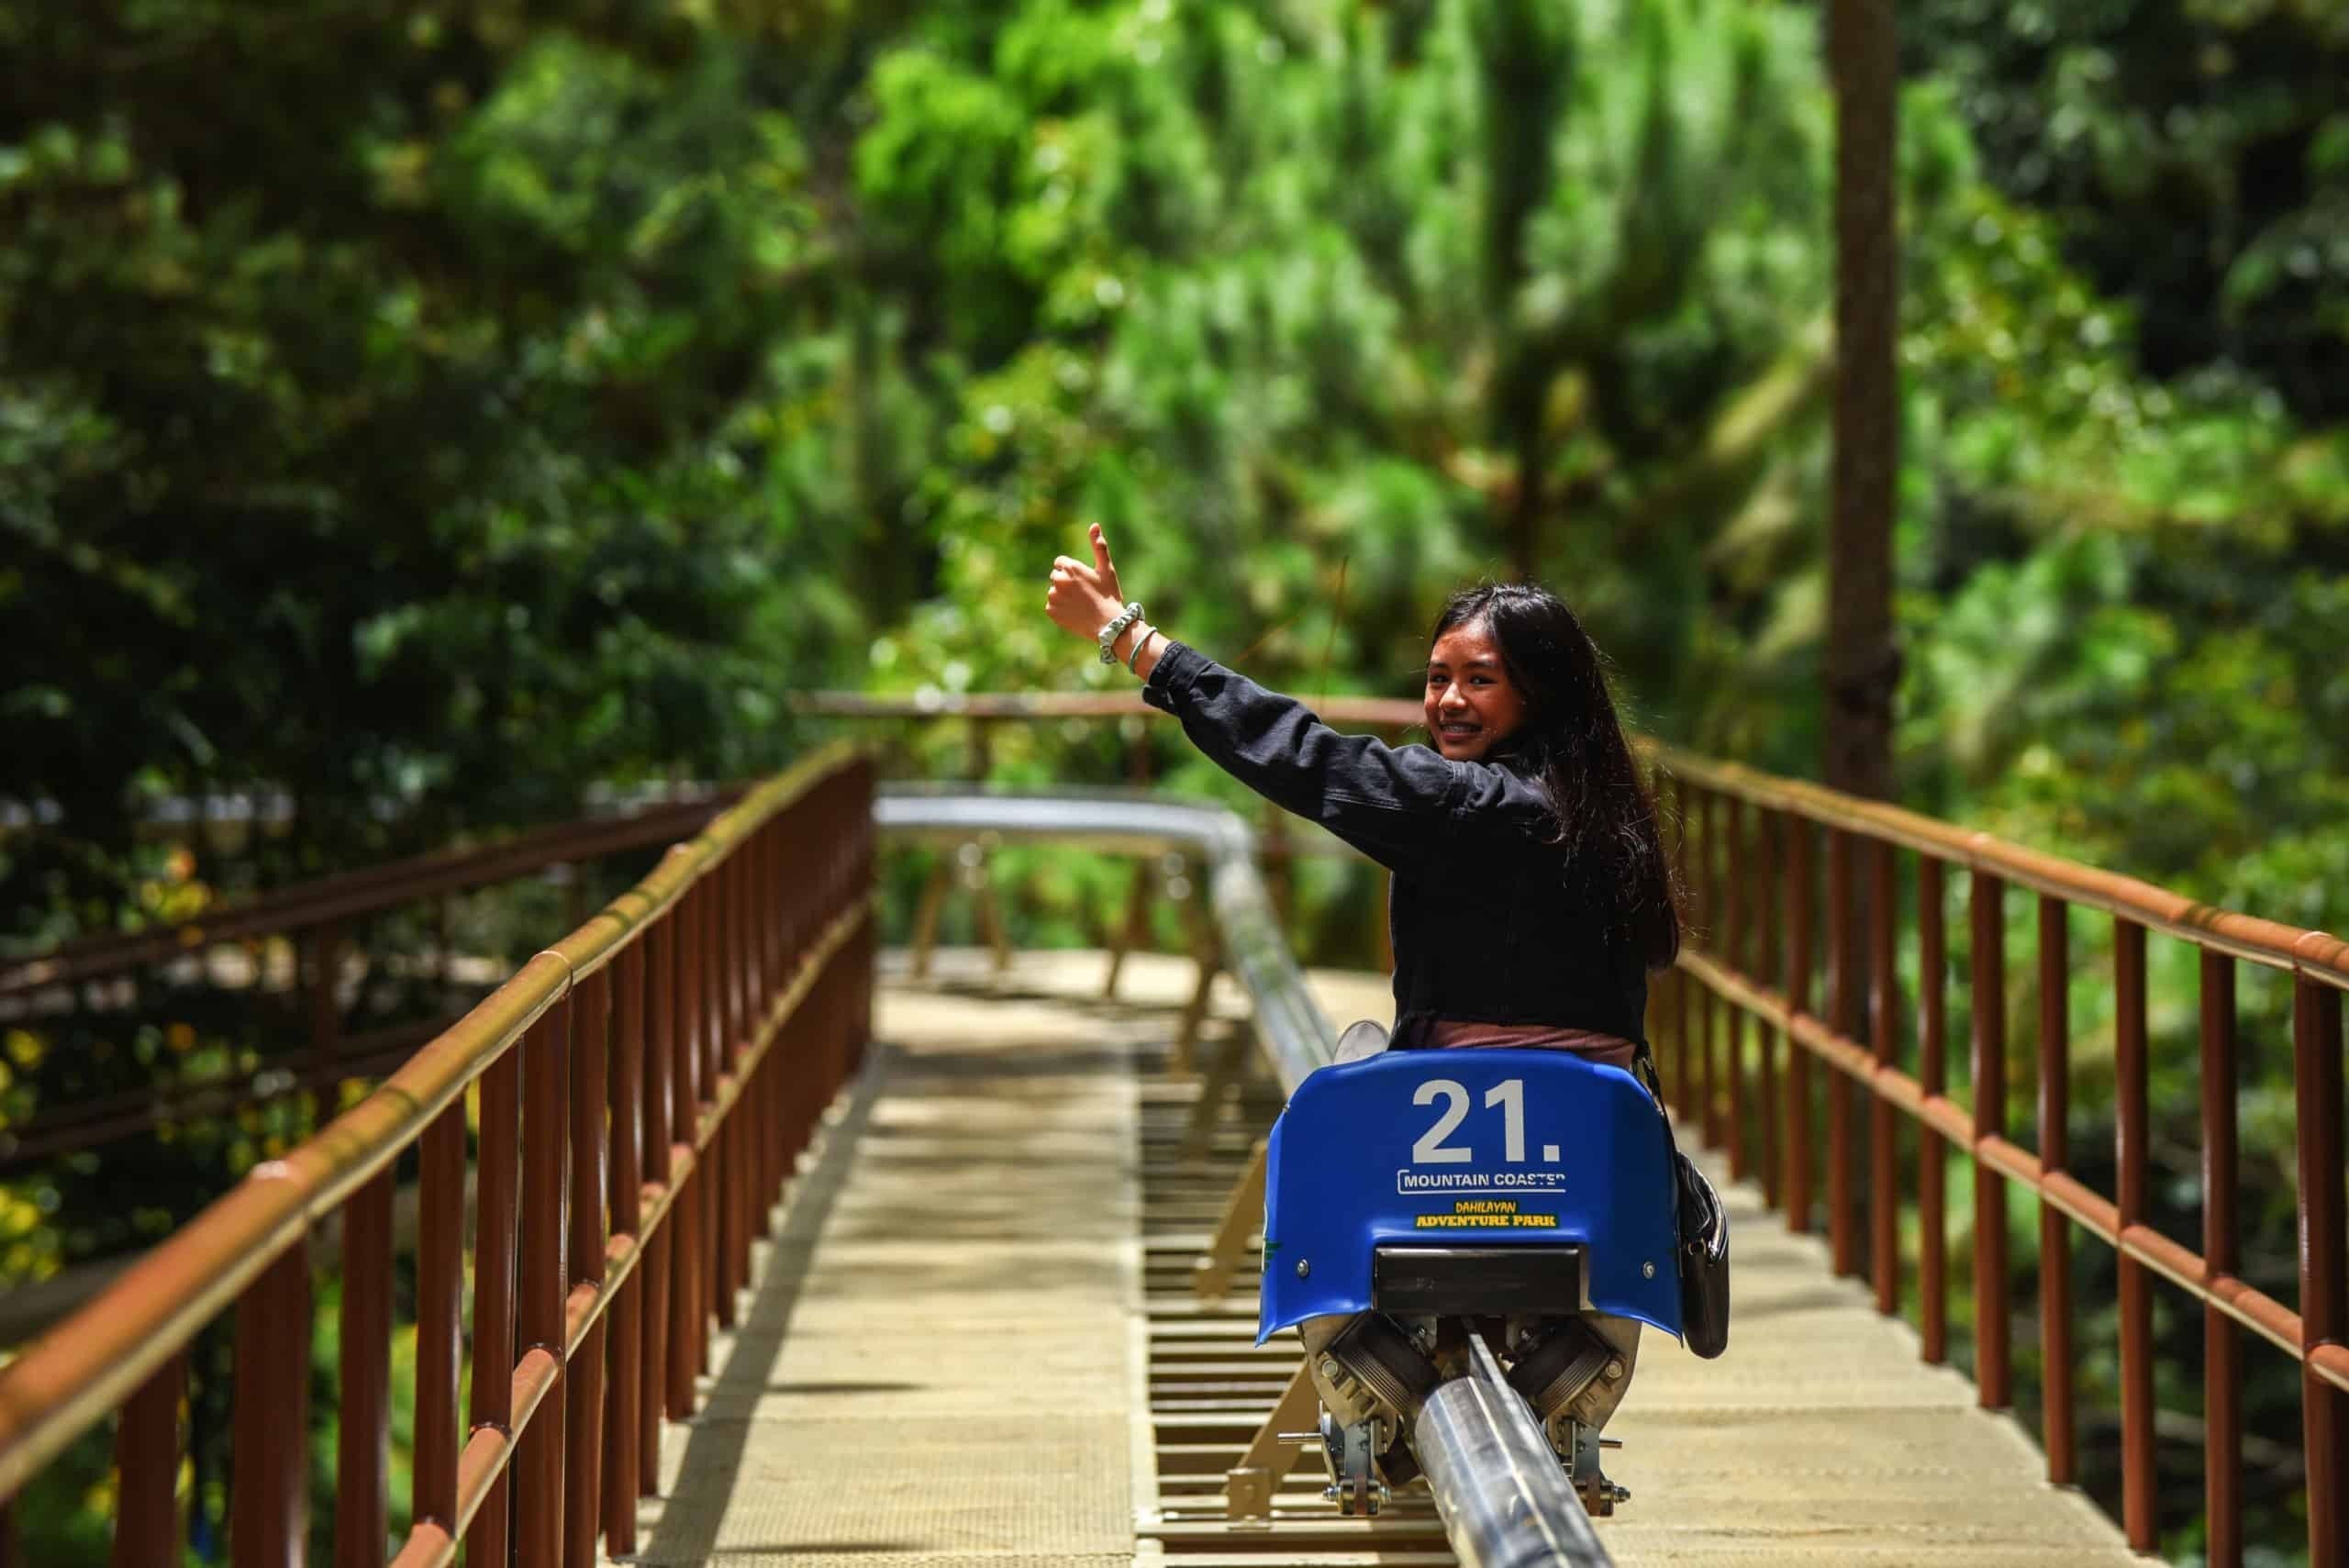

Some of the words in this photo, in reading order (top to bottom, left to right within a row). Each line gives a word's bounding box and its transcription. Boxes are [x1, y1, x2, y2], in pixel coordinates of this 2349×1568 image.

[1412, 1079, 1560, 1163] 21.
[1404, 1174, 1489, 1187] MOUNTAIN
[1455, 1202, 1516, 1214] DAHILAYAN
[1416, 1215, 1509, 1227] ADVENTURE
[1513, 1215, 1556, 1227] PARK
